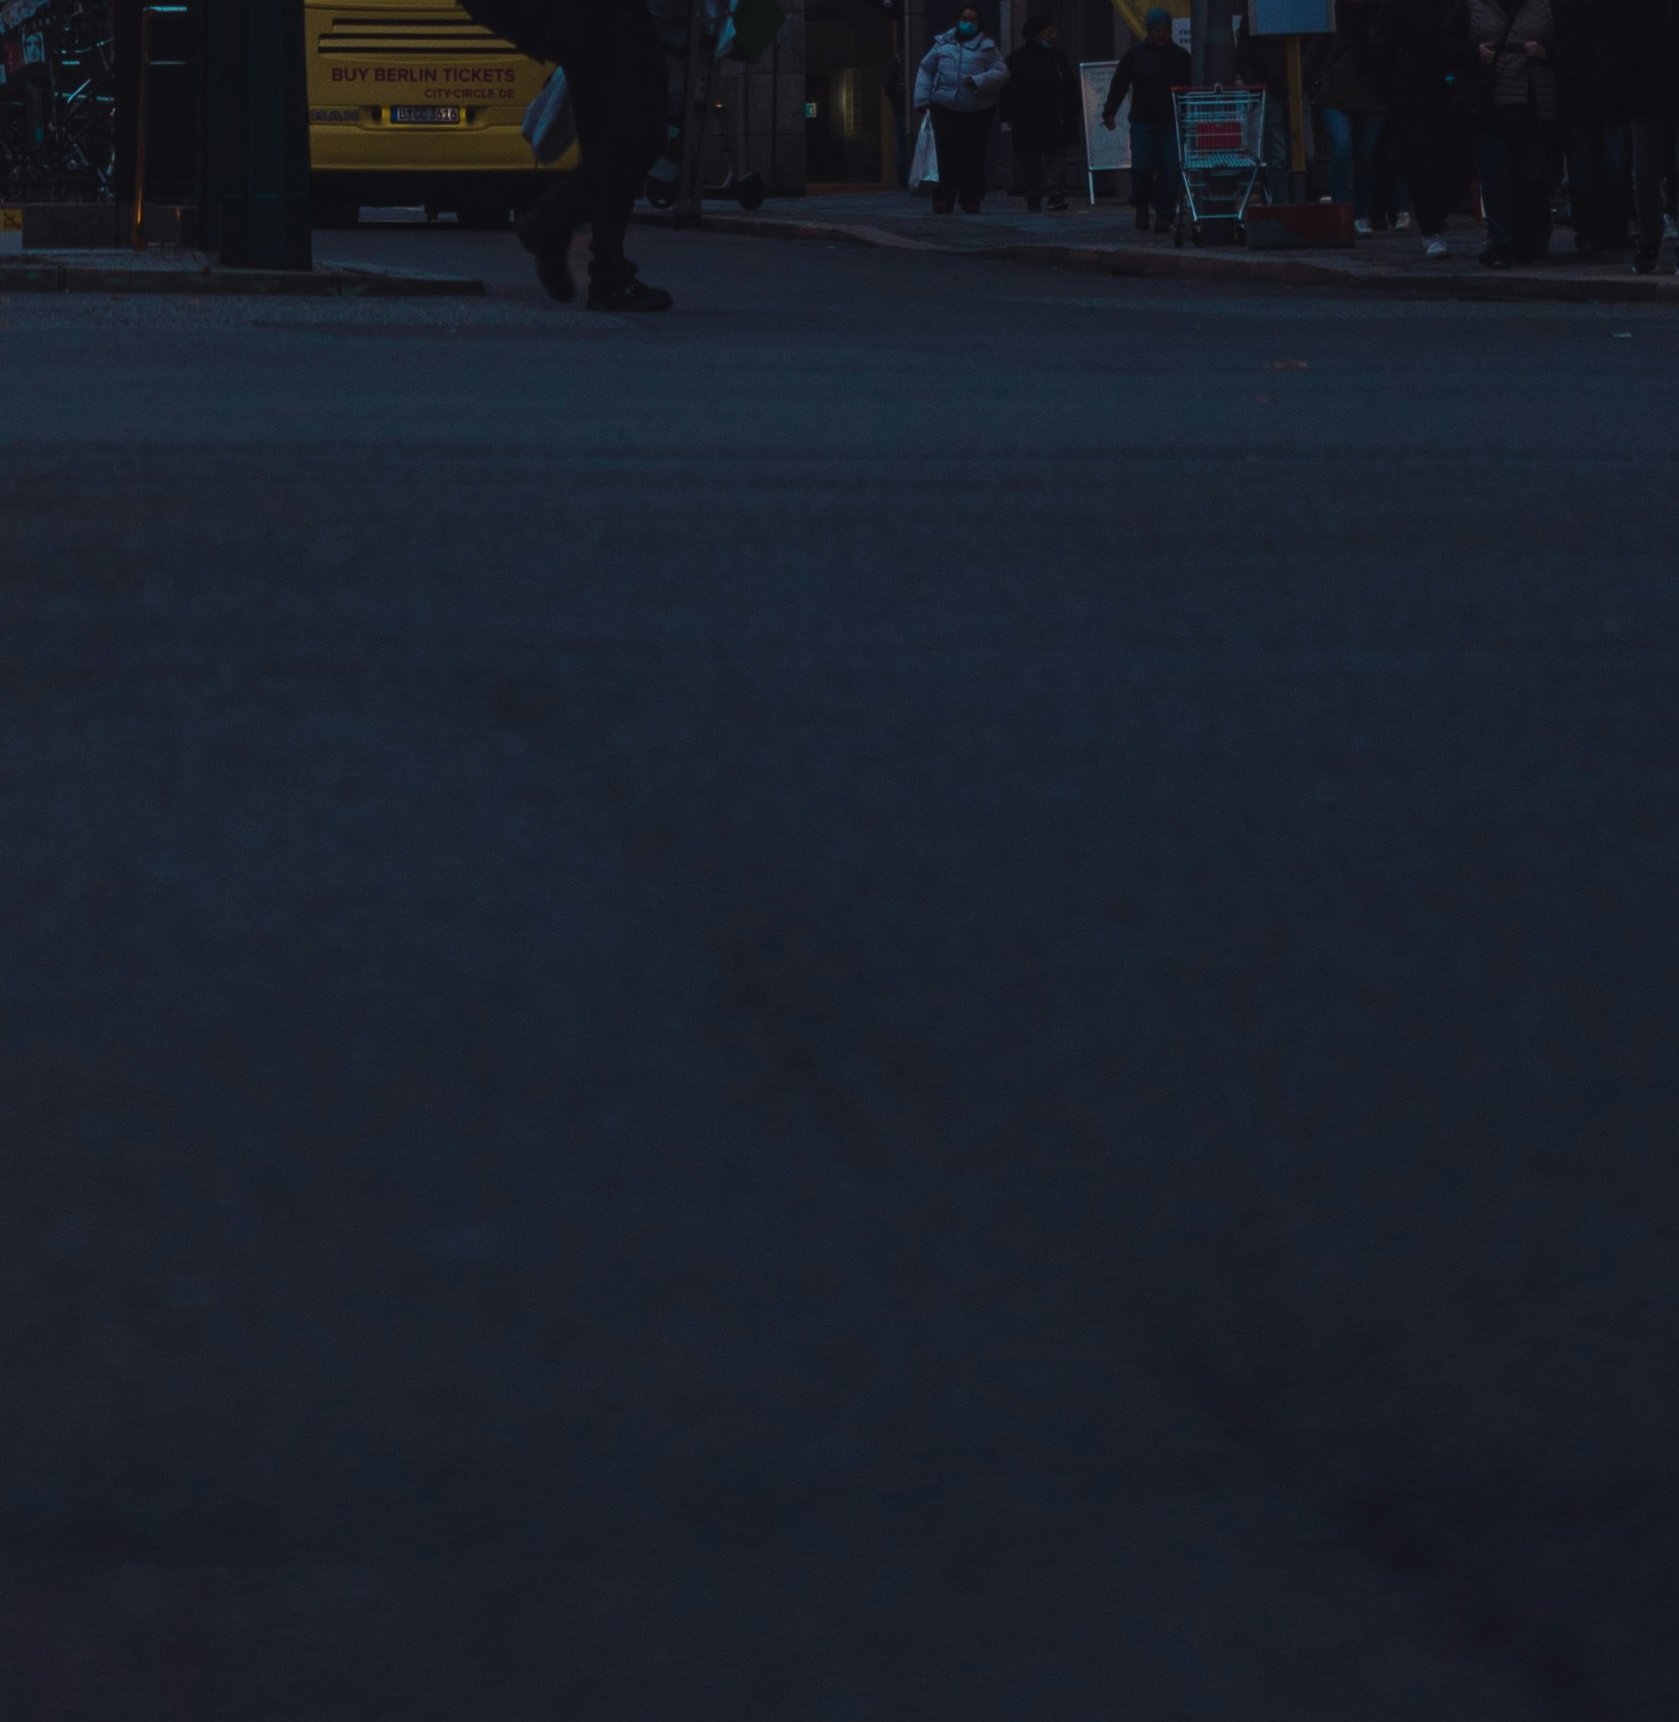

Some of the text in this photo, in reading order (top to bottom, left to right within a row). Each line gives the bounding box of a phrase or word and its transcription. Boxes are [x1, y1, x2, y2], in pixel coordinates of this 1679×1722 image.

[332, 68, 515, 83] BUY BERLIN TICKETS
